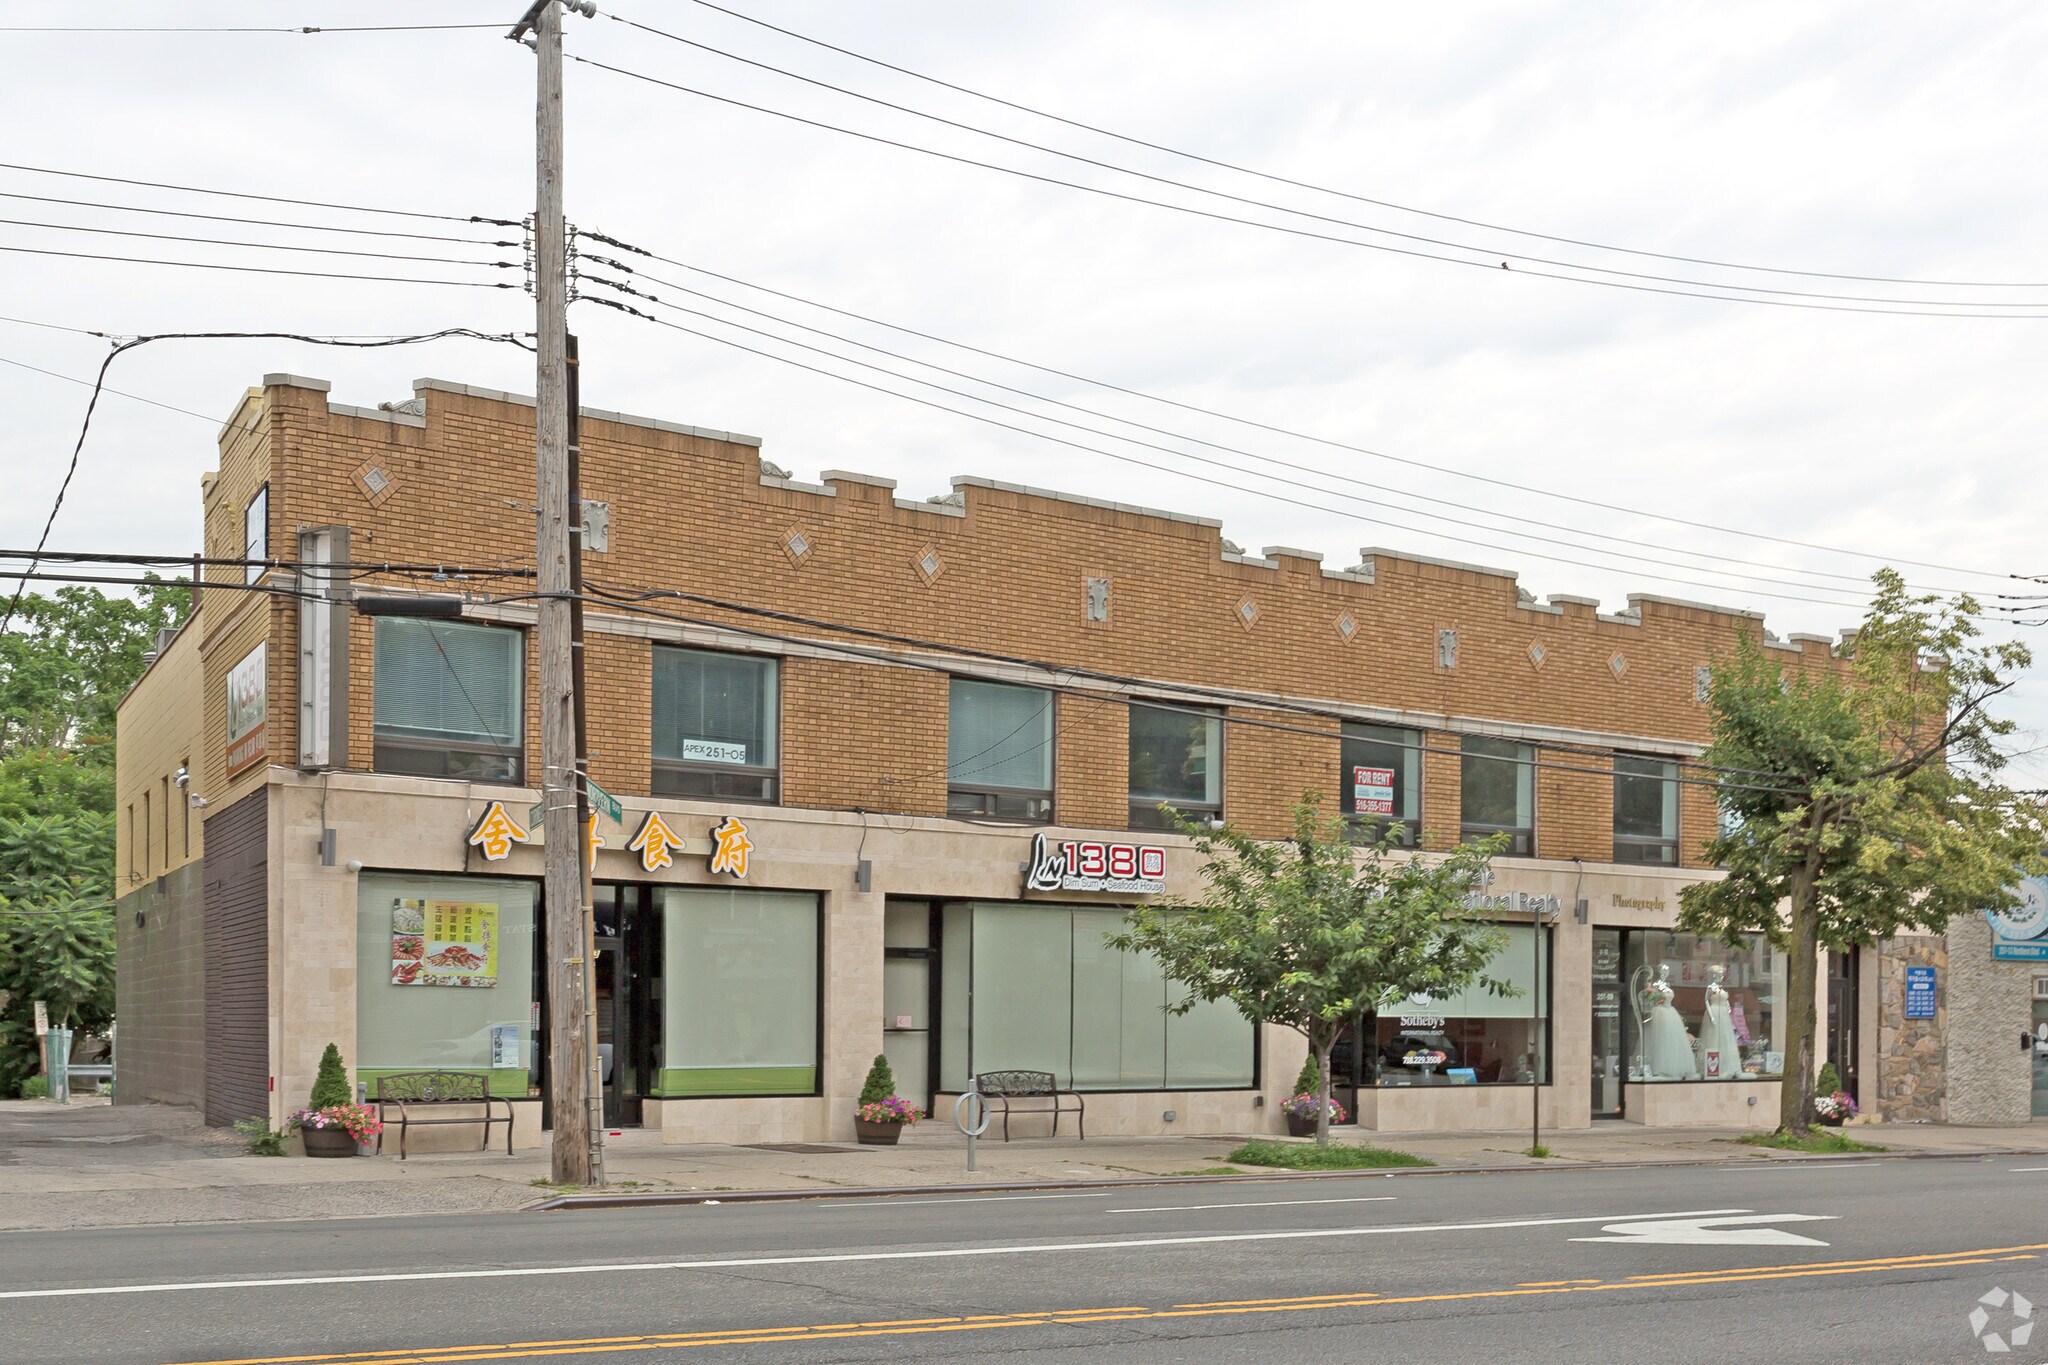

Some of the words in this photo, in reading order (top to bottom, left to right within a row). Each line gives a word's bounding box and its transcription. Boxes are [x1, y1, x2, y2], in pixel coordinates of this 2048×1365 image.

[684, 744, 705, 754] APEX
[706, 746, 745, 760] 251-05
[1357, 770, 1371, 785] FOR
[1372, 772, 1391, 786] RENT
[469, 801, 754, 879] 舍食府
[1064, 842, 1166, 878] 1380
[1064, 876, 1080, 887] Dim
[1081, 877, 1099, 888] Sum
[1107, 878, 1140, 891] Seafood
[1140, 879, 1164, 893] House
[1612, 893, 1666, 911] Photography
[1400, 1012, 1446, 1029] Sotheby's
